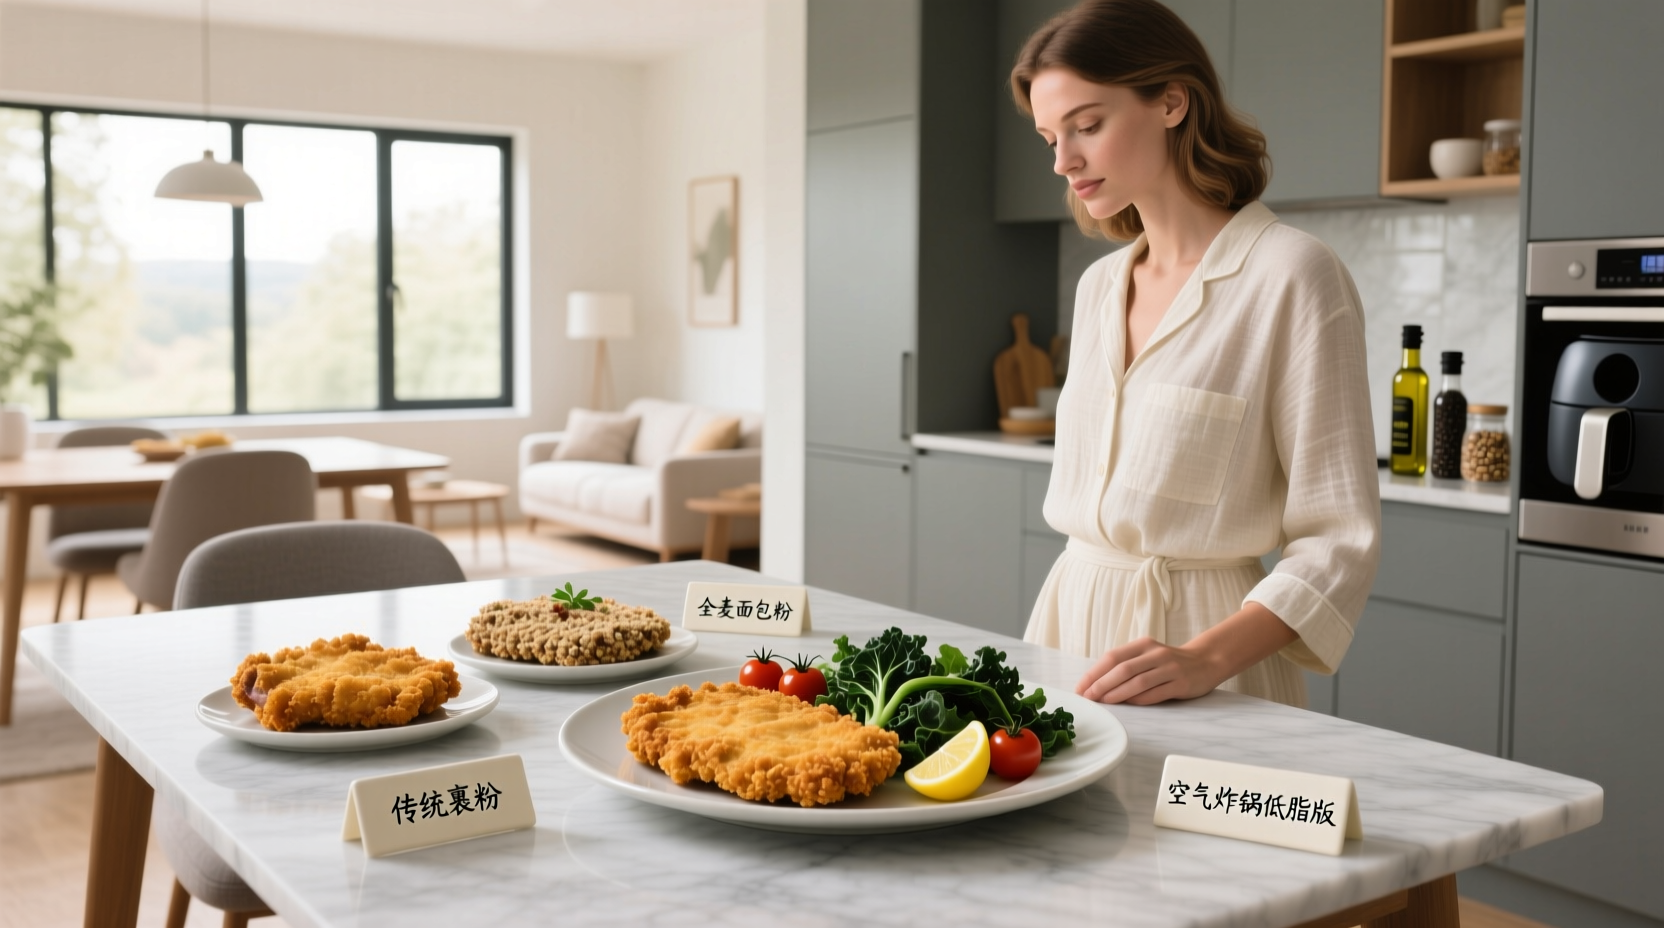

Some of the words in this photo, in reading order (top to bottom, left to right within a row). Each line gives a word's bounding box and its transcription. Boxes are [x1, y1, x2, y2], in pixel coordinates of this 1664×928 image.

[697, 595, 795, 622] 全麦面包粉
[391, 781, 502, 826] 传统裹粉
[1168, 779, 1337, 827] 空气炸锅低脂版
